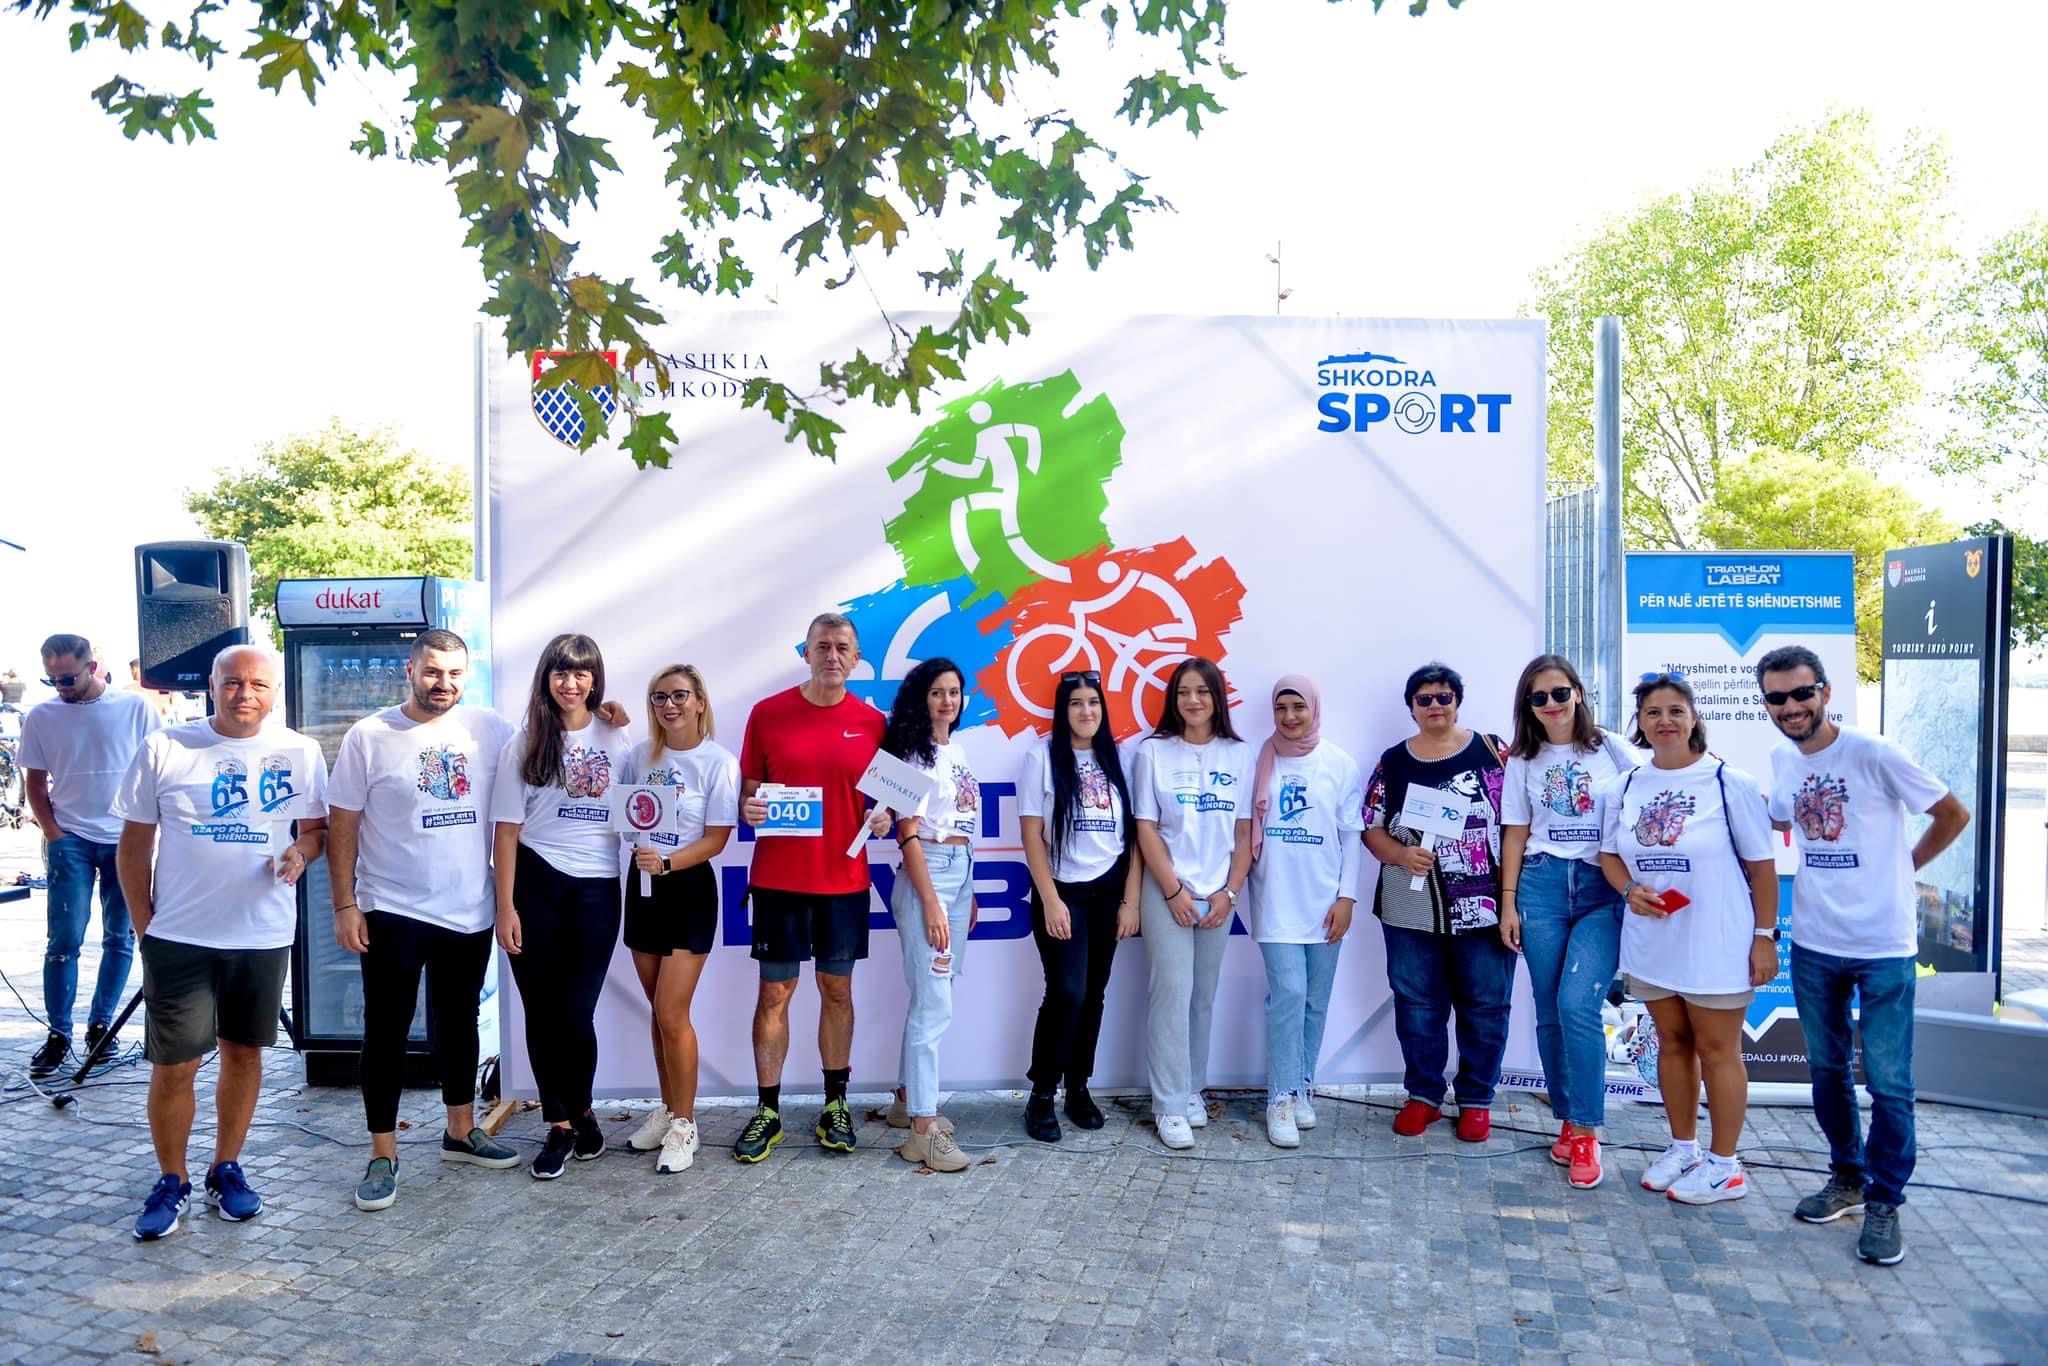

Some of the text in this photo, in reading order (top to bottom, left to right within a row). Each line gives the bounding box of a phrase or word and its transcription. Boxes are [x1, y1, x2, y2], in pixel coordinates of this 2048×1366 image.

[1317, 369, 1437, 387] SHKODRA
[1706, 565, 1780, 573] TRIATHLON
[1707, 574, 1781, 585] LABEAT
[315, 587, 381, 609] dukat
[1639, 593, 1842, 608] PËR NJË JETË TË SHËNDETSHME
[1892, 643, 1974, 653] TOURIST INFO POINT
[1693, 680, 1721, 691] sjellin
[1694, 694, 1740, 704] ndalimin
[1699, 711, 1732, 720] kulare
[1735, 711, 1755, 720] dhe
[211, 774, 248, 810] 65
[259, 770, 293, 805] 65
[1280, 784, 1307, 814] 65
[767, 803, 810, 821] 040
[1740, 1053, 1808, 1063] EDALOJ #VRA
[1604, 1084, 1645, 1096] TSHME
